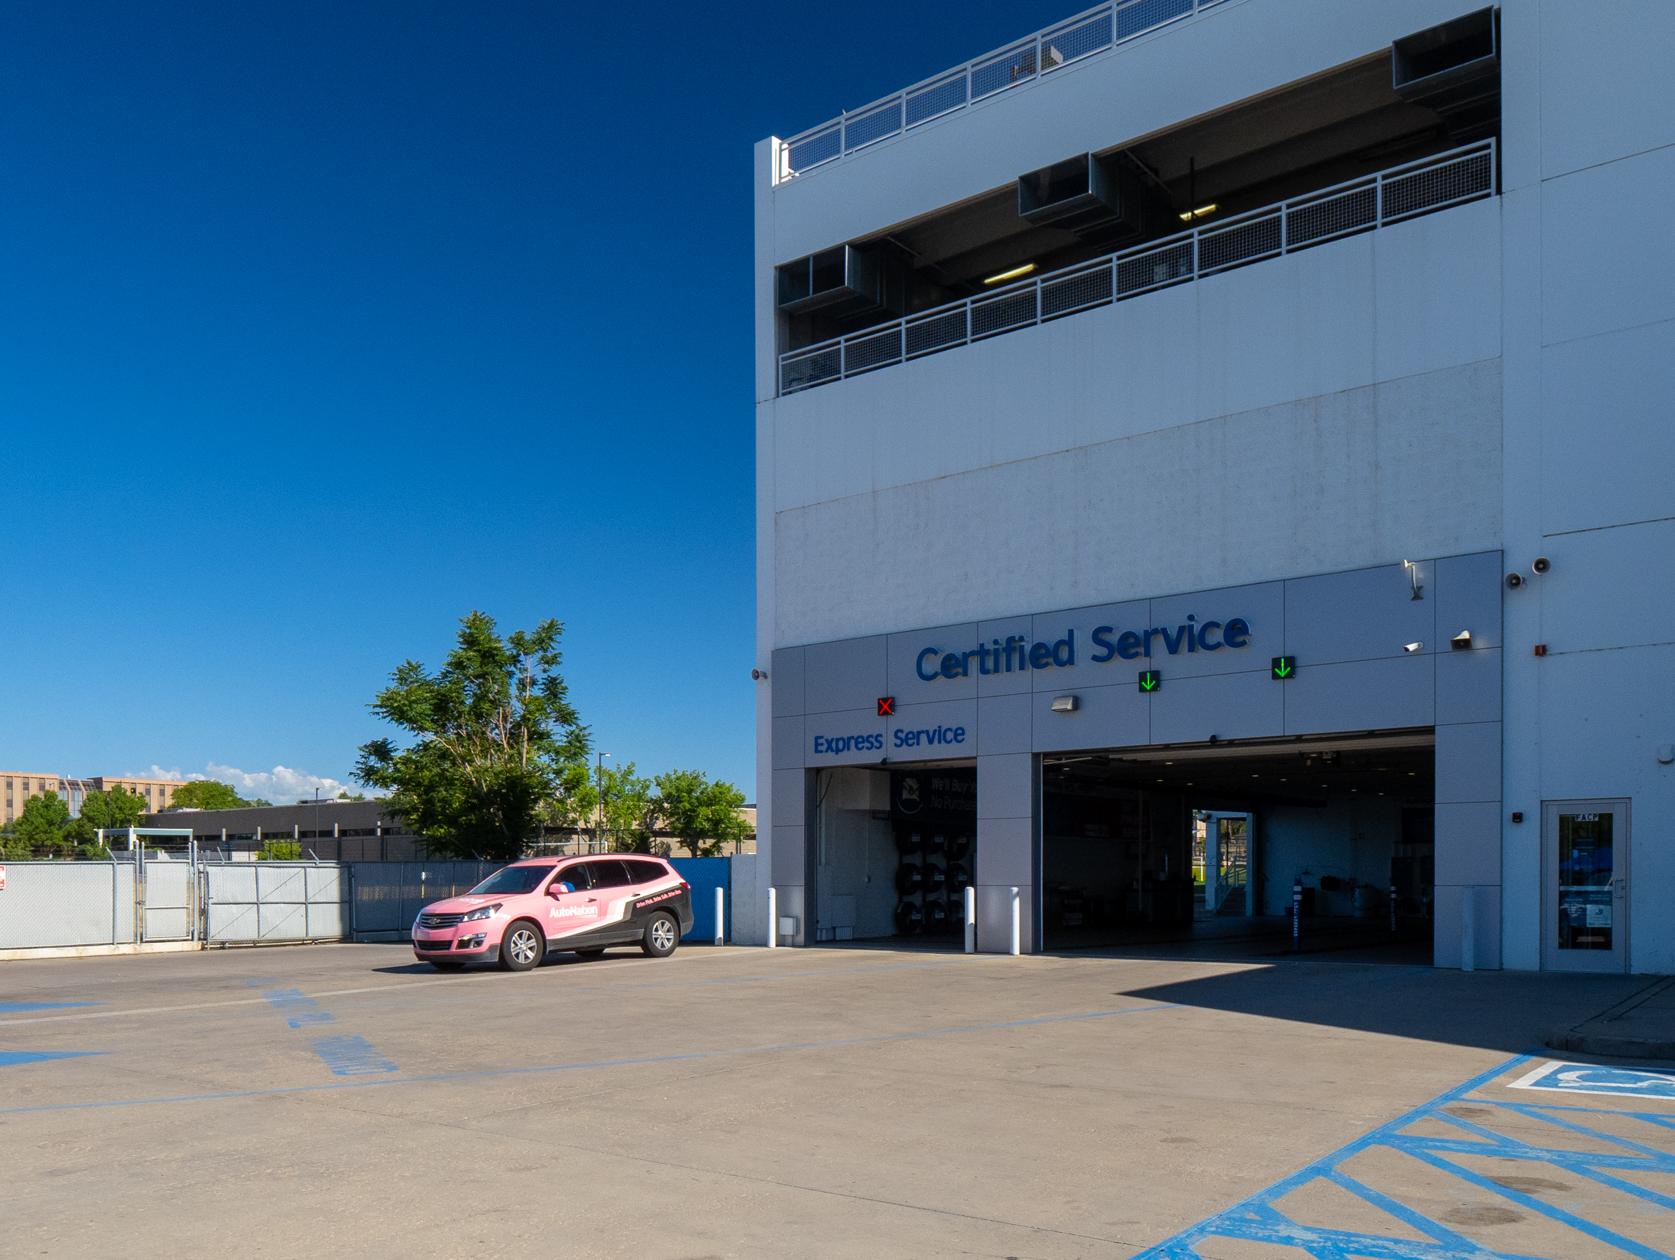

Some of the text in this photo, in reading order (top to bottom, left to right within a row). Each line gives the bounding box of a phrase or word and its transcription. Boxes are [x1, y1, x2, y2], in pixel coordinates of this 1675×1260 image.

[916, 613, 1252, 682] Certified Service
[814, 725, 966, 755] Express Service
[549, 904, 598, 918] AutoNation
